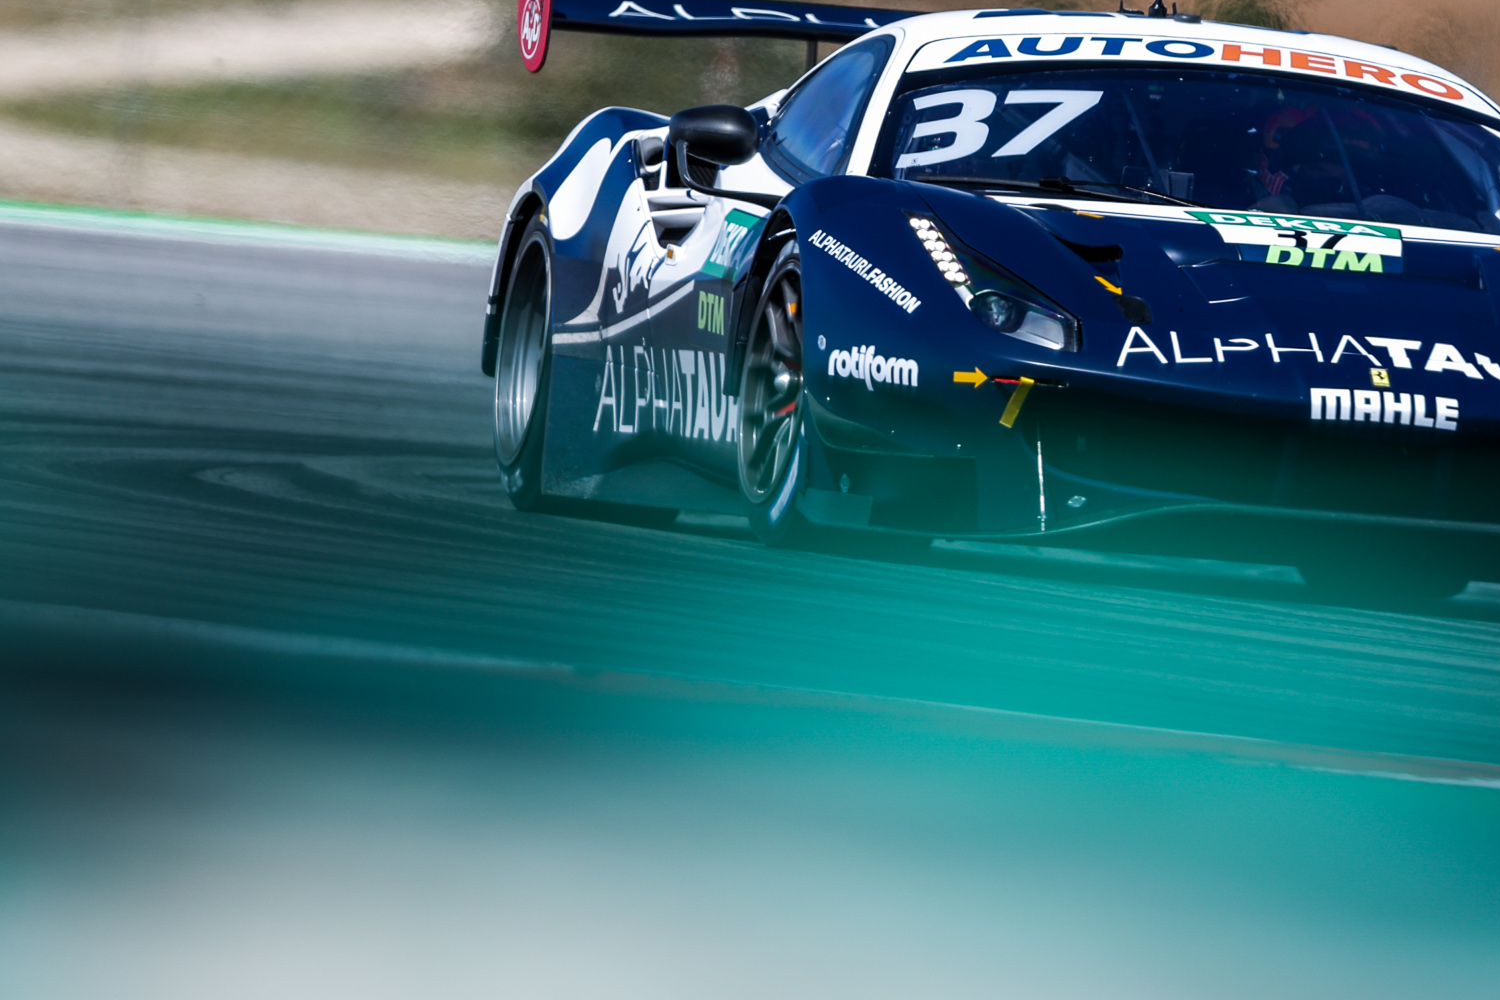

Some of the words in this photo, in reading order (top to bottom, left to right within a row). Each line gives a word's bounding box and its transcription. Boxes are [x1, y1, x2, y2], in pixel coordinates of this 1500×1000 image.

[943, 36, 1465, 101] AUTOHERO
[895, 88, 1104, 169] 37
[1208, 213, 1387, 237] DEKRA
[808, 229, 921, 314] ALPHATAURI.FASHION
[1265, 244, 1383, 273] DTM
[698, 290, 724, 336] DTM
[828, 344, 918, 391] rotiform
[1309, 387, 1459, 431] MAHLE
